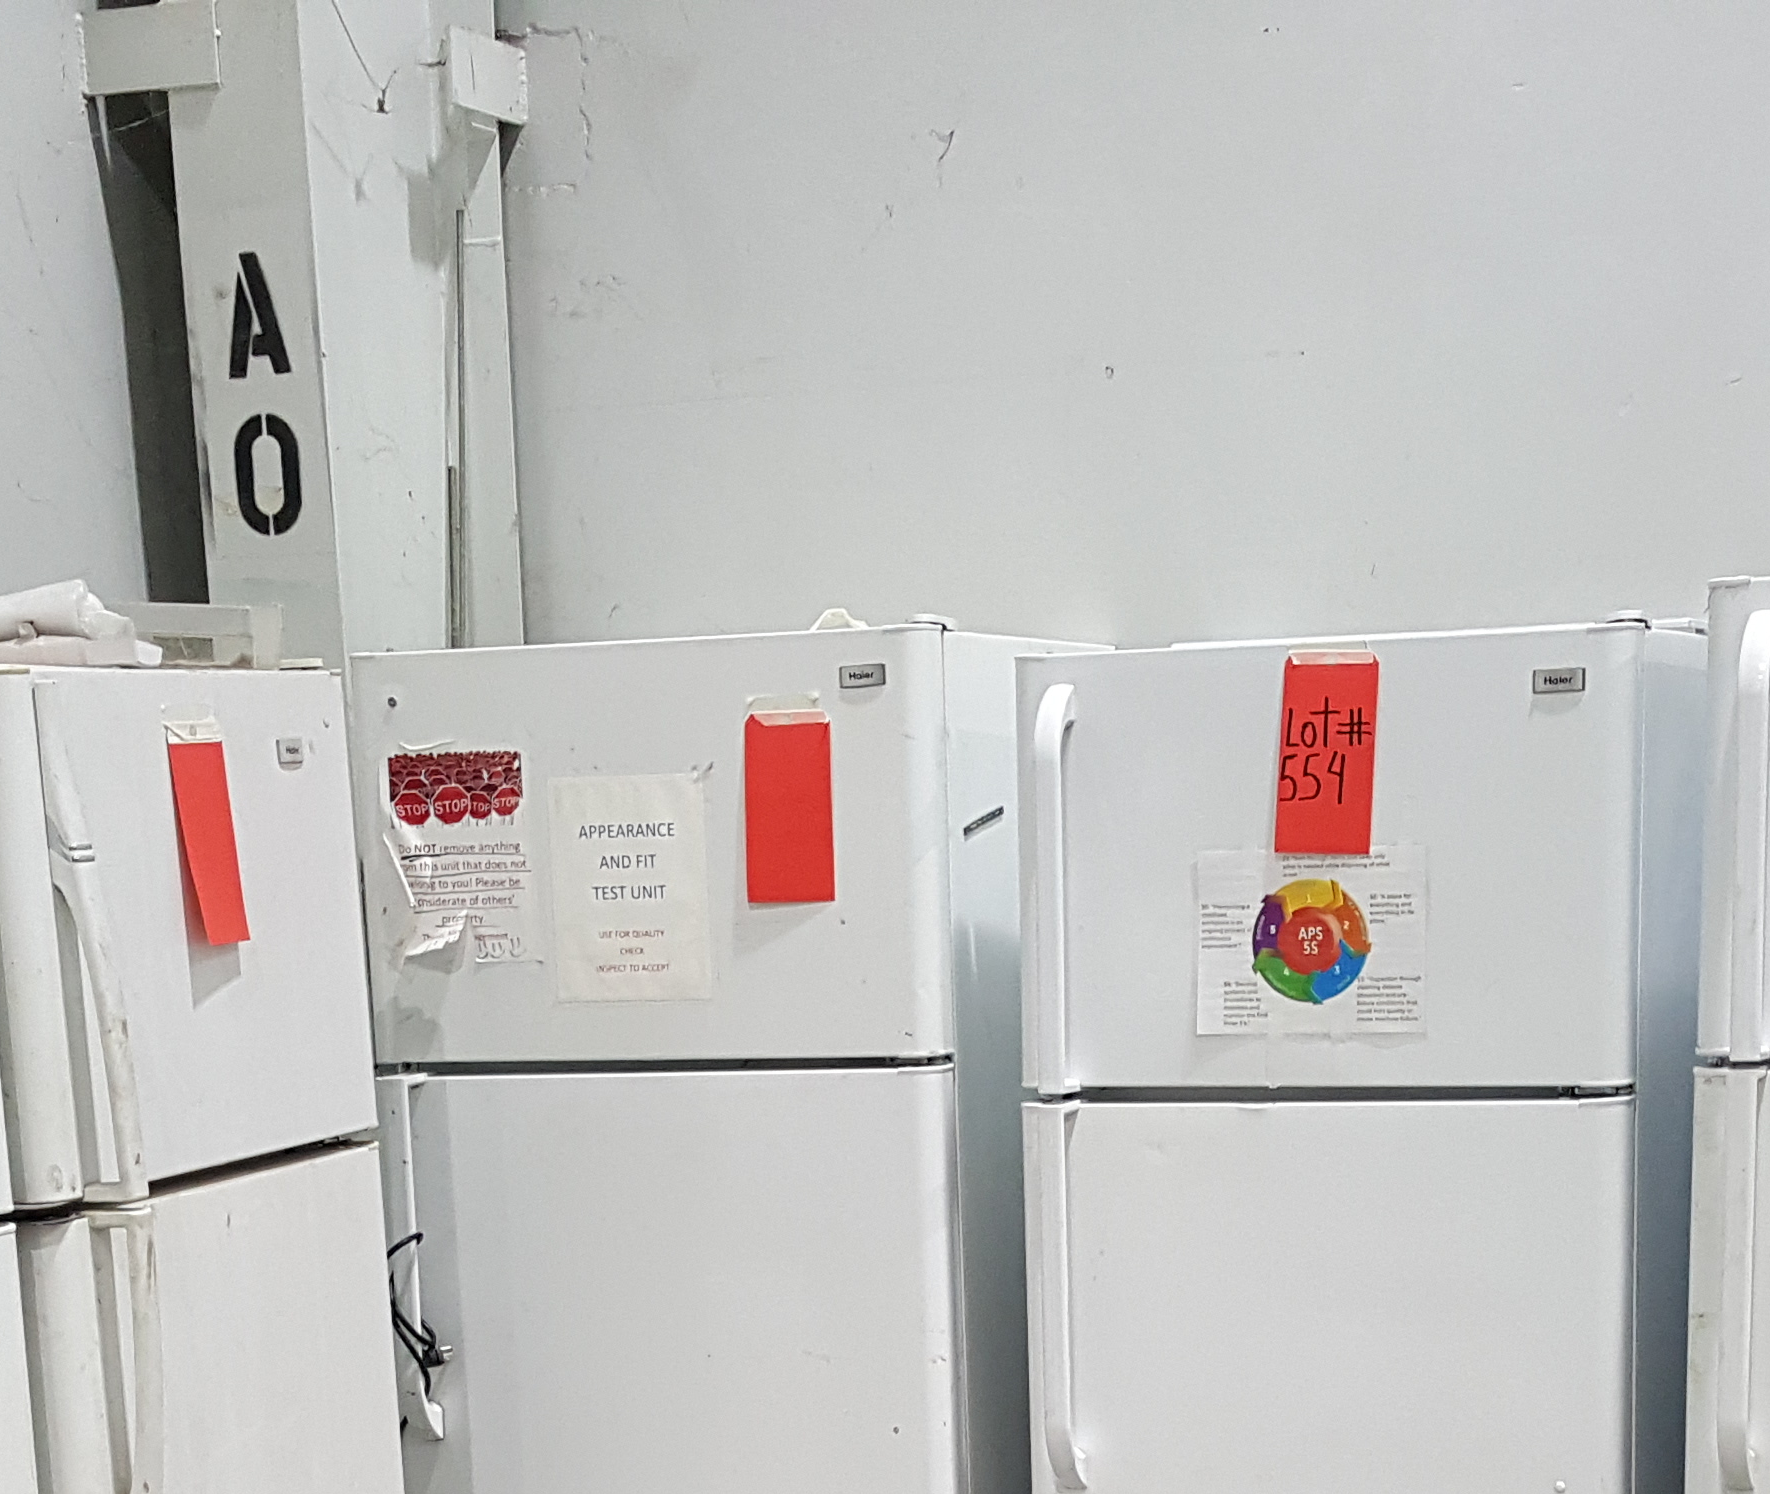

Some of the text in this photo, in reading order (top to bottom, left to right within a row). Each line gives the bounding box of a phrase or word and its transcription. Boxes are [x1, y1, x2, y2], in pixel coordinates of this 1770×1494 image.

[1278, 750, 1347, 805] 554
[434, 799, 468, 815] STOP
[472, 802, 491, 812] TOP
[493, 797, 520, 808] STOP
[395, 804, 429, 817] STOP
[579, 822, 675, 839] APPEARANCE
[415, 844, 436, 853] NOT
[439, 844, 475, 854] remove
[479, 841, 520, 854] anything
[420, 861, 438, 871] this
[440, 861, 460, 871] unit
[462, 860, 482, 870] that
[599, 853, 656, 869] AND FIT
[438, 880, 448, 889] to
[592, 885, 666, 900] TEST UNIT
[469, 895, 479, 905] of
[1298, 926, 1324, 940] APS
[1303, 940, 1319, 955] 5S
